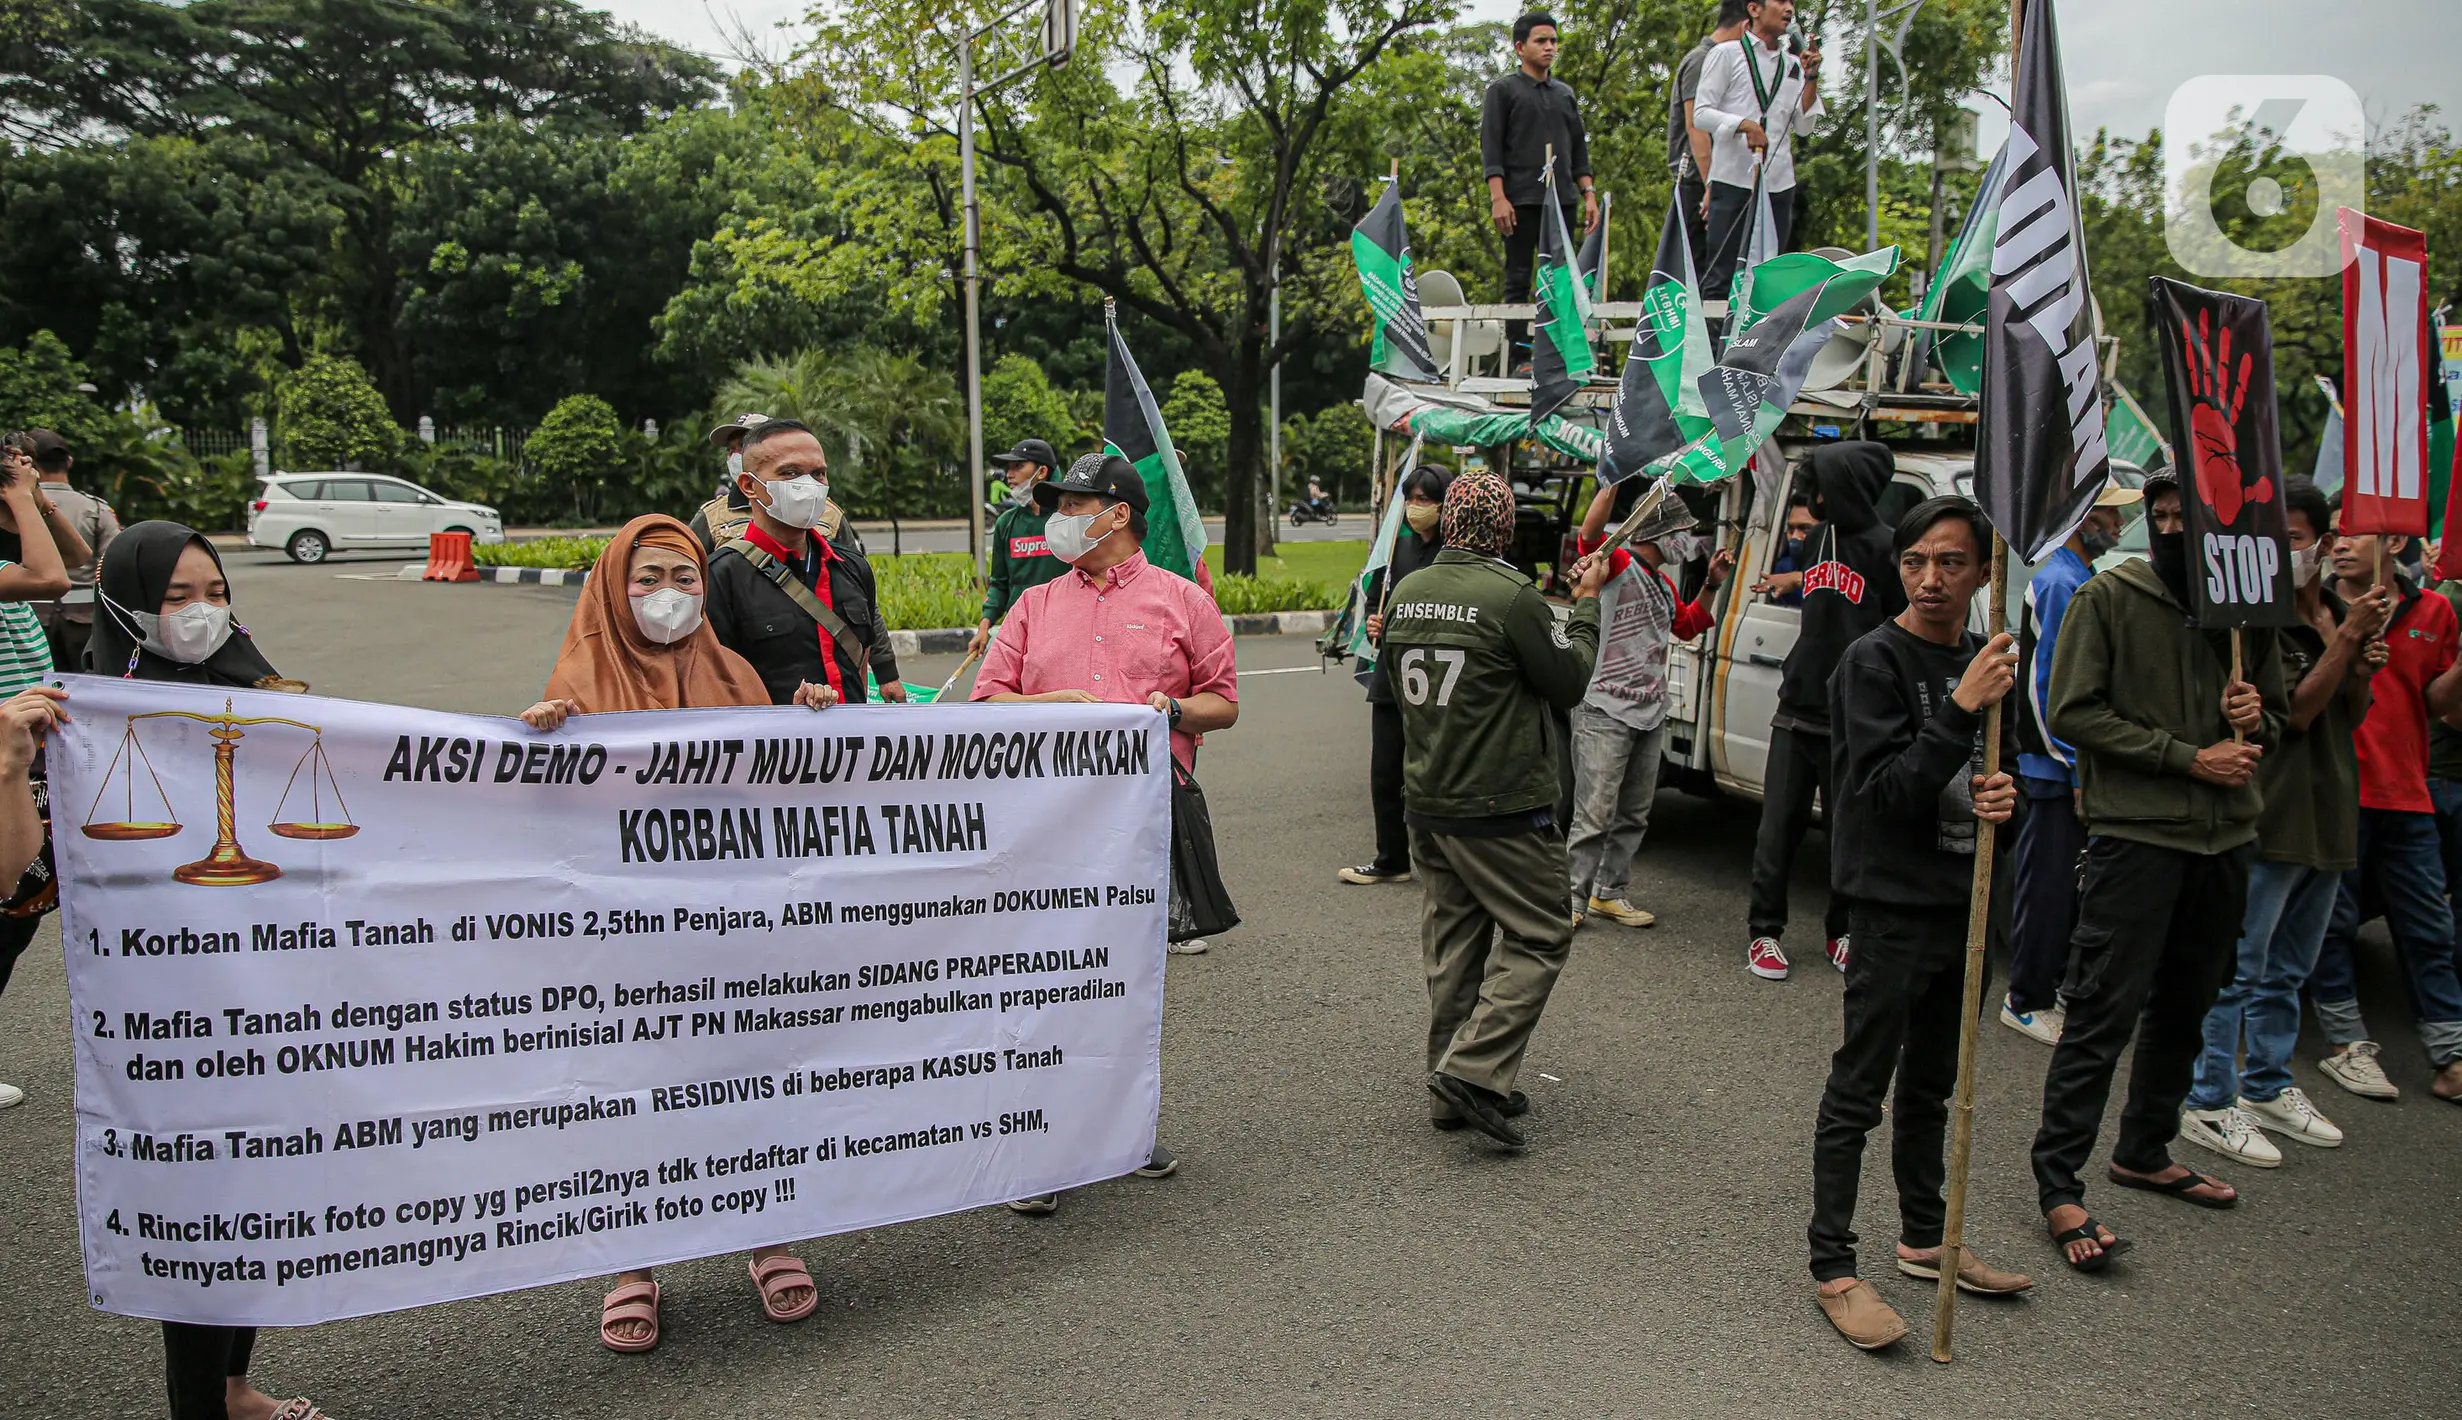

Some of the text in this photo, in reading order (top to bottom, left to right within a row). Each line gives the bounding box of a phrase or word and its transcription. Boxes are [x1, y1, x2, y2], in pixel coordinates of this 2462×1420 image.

[1656, 286, 1682, 330] LKBHMI
[1013, 539, 1048, 555] Supre
[2203, 532, 2279, 605] STOP
[1396, 603, 1479, 624] ENSEMBLE
[1401, 648, 1466, 707] 67
[382, 734, 486, 783] AKSI
[493, 741, 608, 786] DEMO
[635, 739, 744, 785] JAHIT
[747, 736, 865, 785] MULUT
[867, 734, 934, 782] DAN
[937, 731, 1048, 780] MOGOK
[1052, 729, 1150, 778] MAKAN
[619, 802, 988, 863] KORBAN MAFIA TANAH
[89, 884, 1155, 957] 1. Korban Mafia Tanah di VONIS 2,5thn Penjara, ABM menggunakan DOKUMEN Palsu
[92, 946, 1109, 1040] 2. Mafia Tanah dengan status DPO, berhasil melakukan SIDANG PRAPERADILAN
[126, 978, 1126, 1081] dan oleh OKNUM Hakim berinisial AJT PN Makassar mengabulkan praperadilan
[102, 1044, 1063, 1163] 3. Mafia Tanah ABM yang merupakan RESIDIVIS di beberapa KASUS Tanah
[106, 1108, 1049, 1243] 4. Rincik/Girik foto copy yg persil2nya tdk terdaftar di kecamatan vs SHM,
[140, 1177, 796, 1288] ternyata pemenangnya Rincik/Girik foto copy !!!
